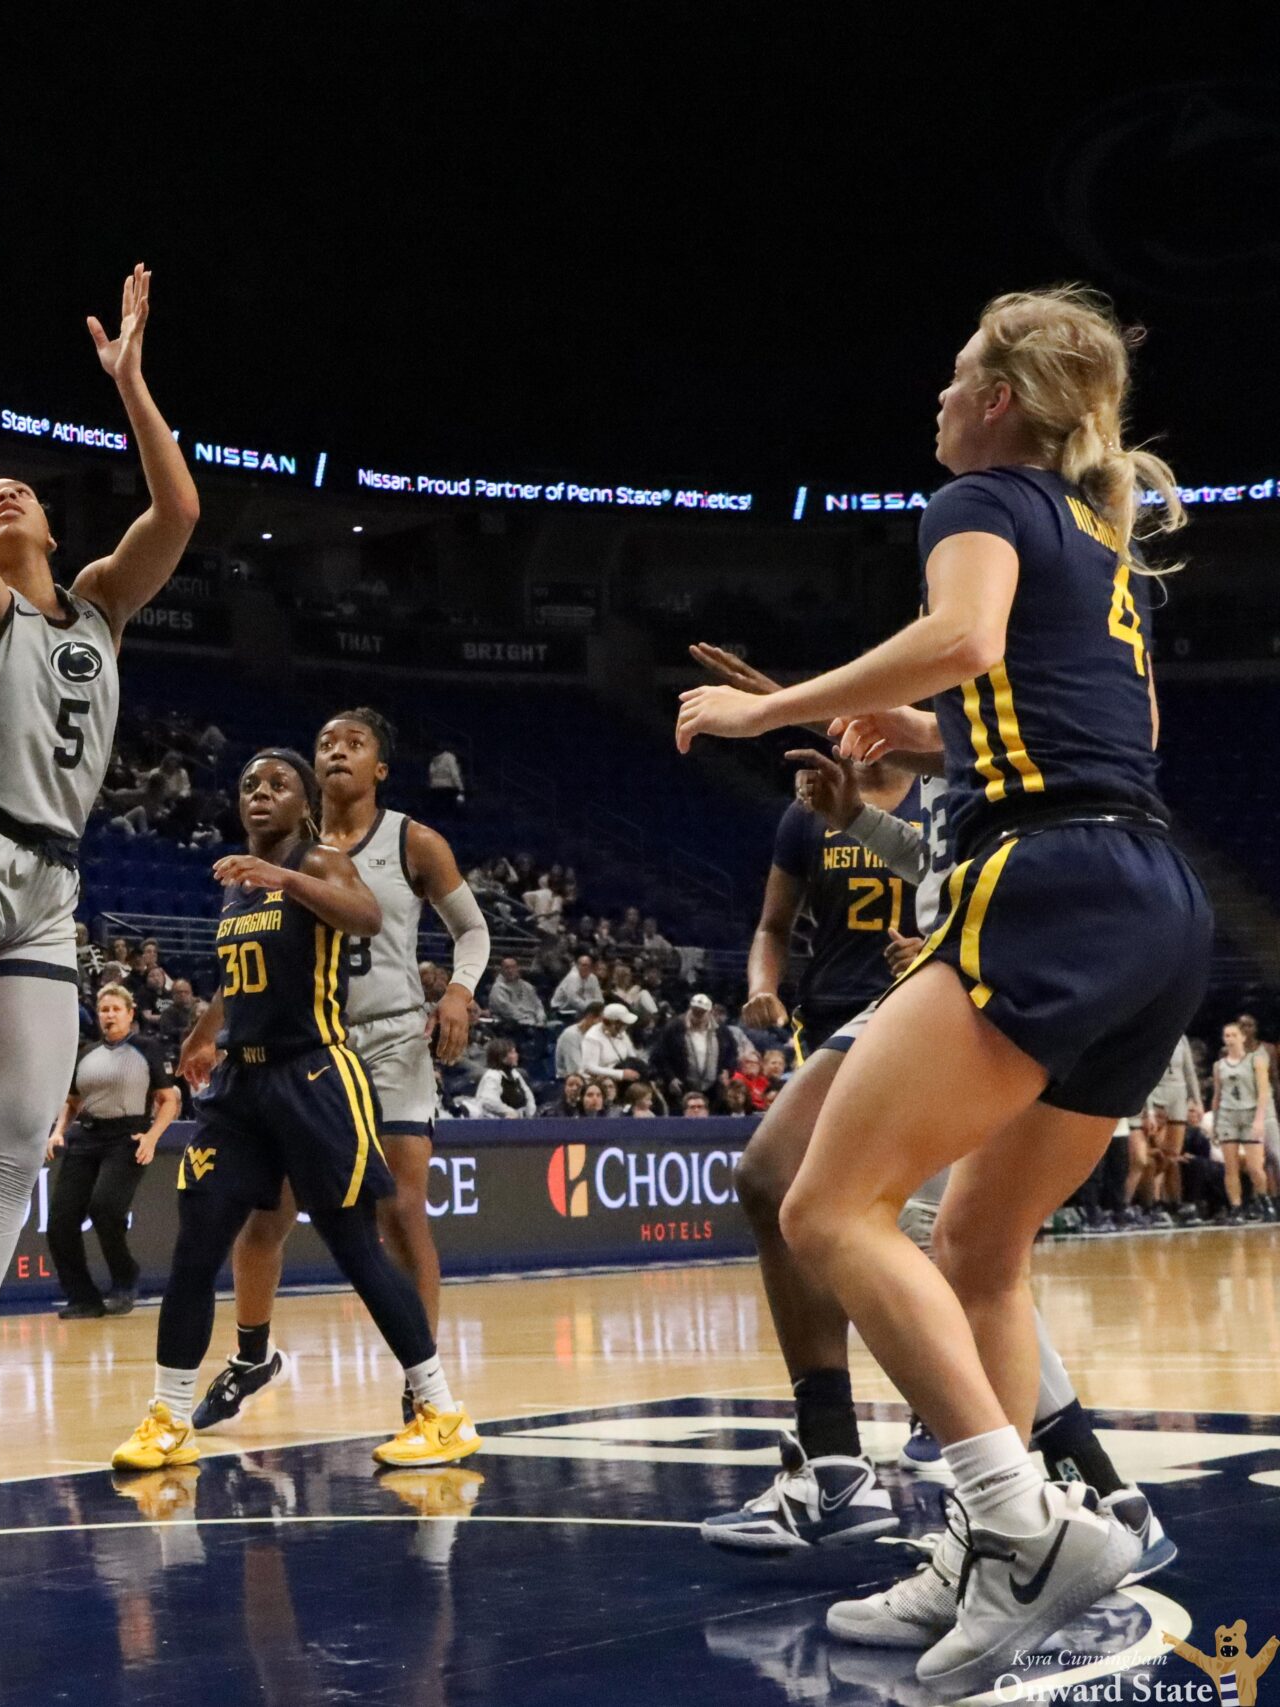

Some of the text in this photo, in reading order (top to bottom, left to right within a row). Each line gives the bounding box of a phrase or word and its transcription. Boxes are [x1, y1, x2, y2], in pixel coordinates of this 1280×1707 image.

[52, 422, 127, 451] Athletics!
[194, 442, 297, 476] NISSAN
[358, 468, 415, 493] Nissan.
[417, 475, 471, 497] Proud
[474, 479, 542, 500] Partner
[545, 482, 565, 502] of
[566, 484, 613, 503] Penn
[674, 490, 752, 511] Athletics!
[825, 492, 928, 512] NISSA
[1249, 479, 1275, 500] of
[1107, 564, 1145, 677] 4
[336, 631, 384, 655] THAT
[461, 641, 548, 664] BRIGHT
[54, 698, 90, 769] 5
[823, 846, 860, 870] WEST
[847, 877, 902, 931] 21
[233, 909, 282, 936] VIRGINIA
[217, 941, 268, 998] 30
[641, 1220, 713, 1241] HOTELS
